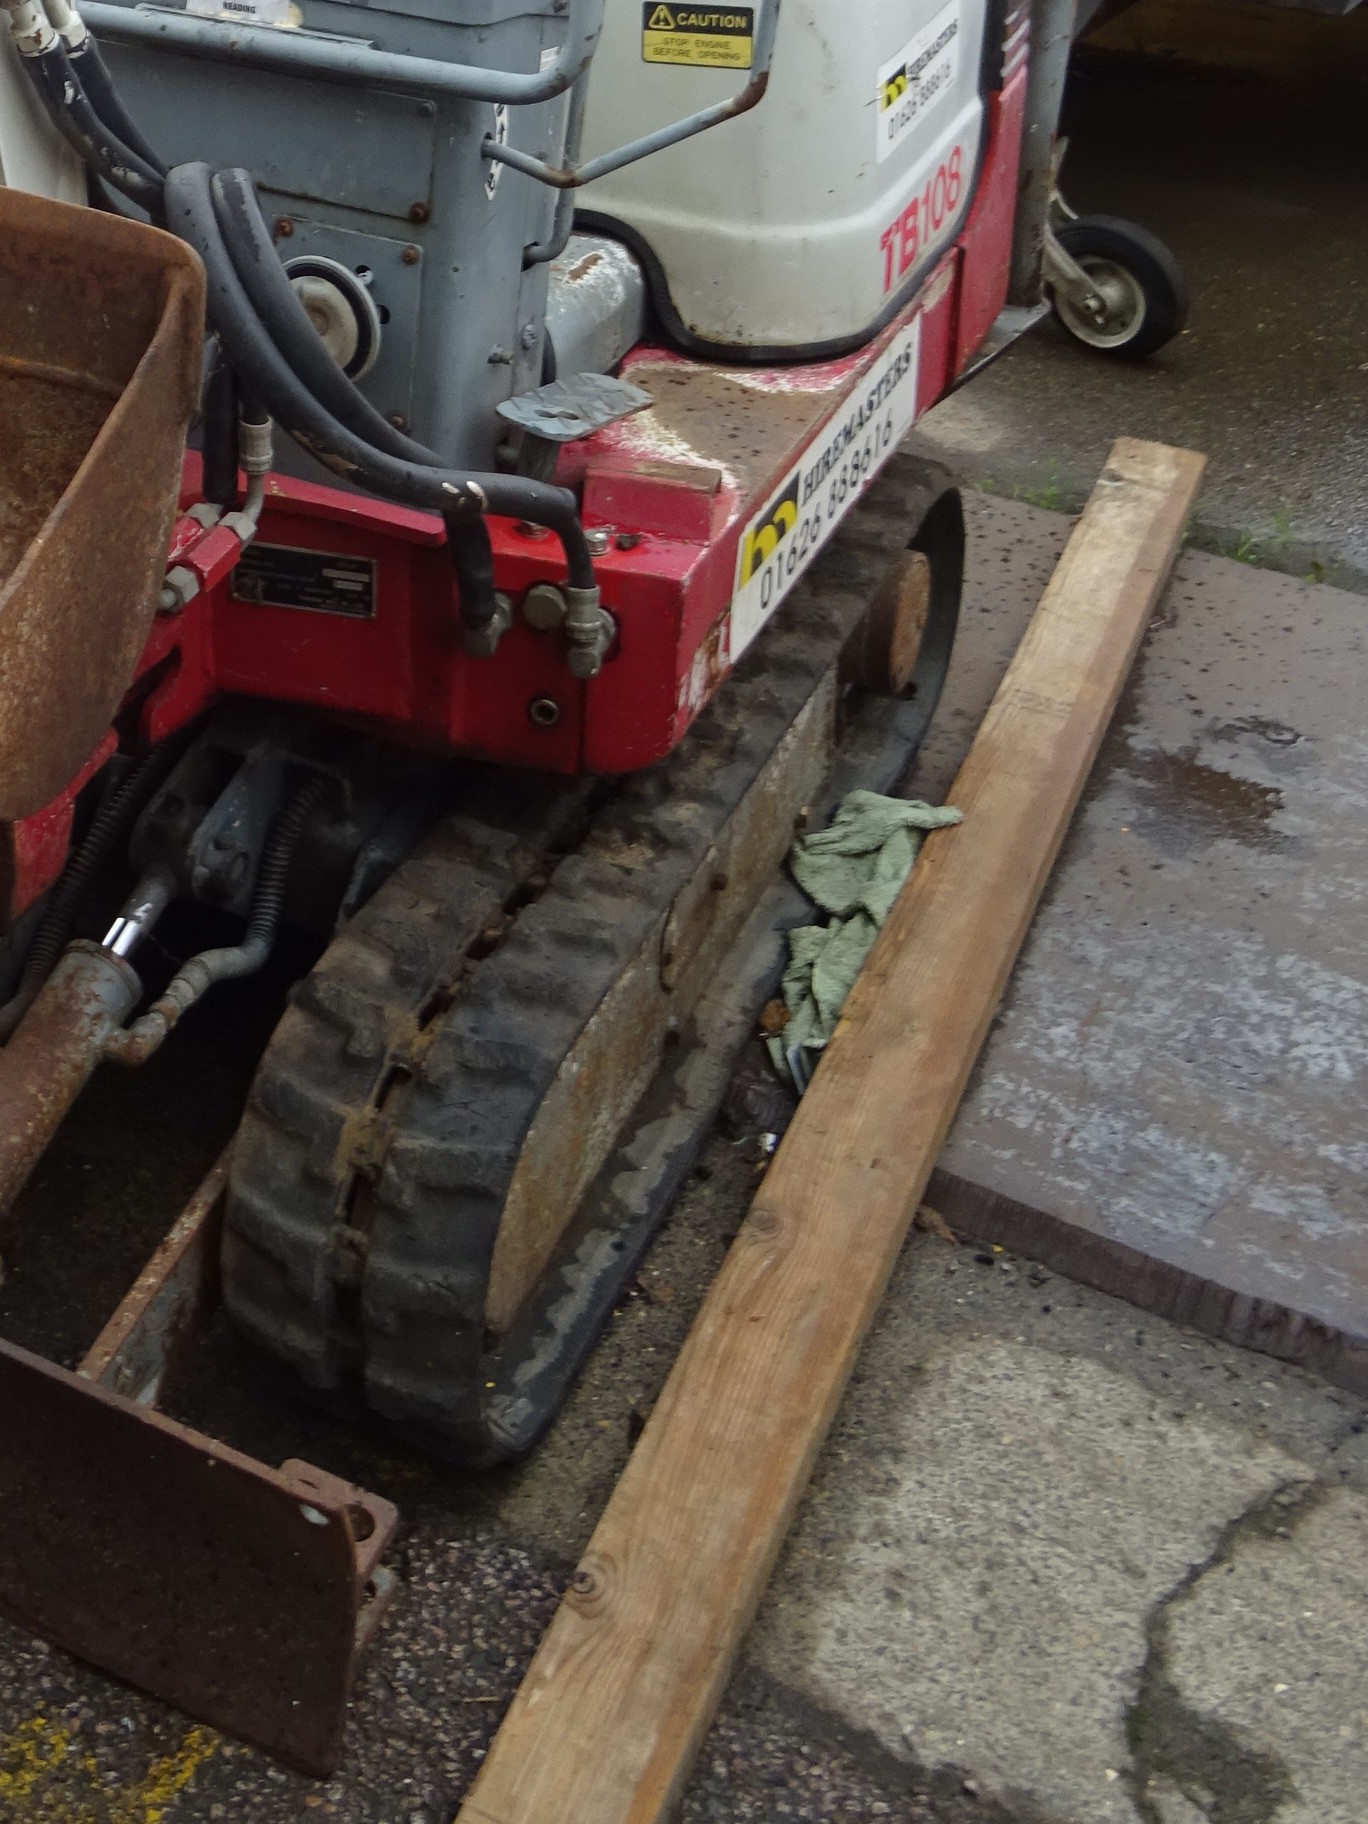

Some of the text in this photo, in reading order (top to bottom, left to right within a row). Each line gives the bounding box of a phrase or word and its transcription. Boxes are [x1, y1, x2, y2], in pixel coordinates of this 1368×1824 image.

[222, 1, 257, 14] READING
[676, 12, 747, 29] CAUTION
[663, 37, 731, 50] STOP ENGINE
[653, 47, 740, 61] BEFORE OPENING
[880, 144, 962, 294] TB108
[801, 341, 913, 507] HIREMASTERS
[760, 408, 893, 609] 01626 888616
